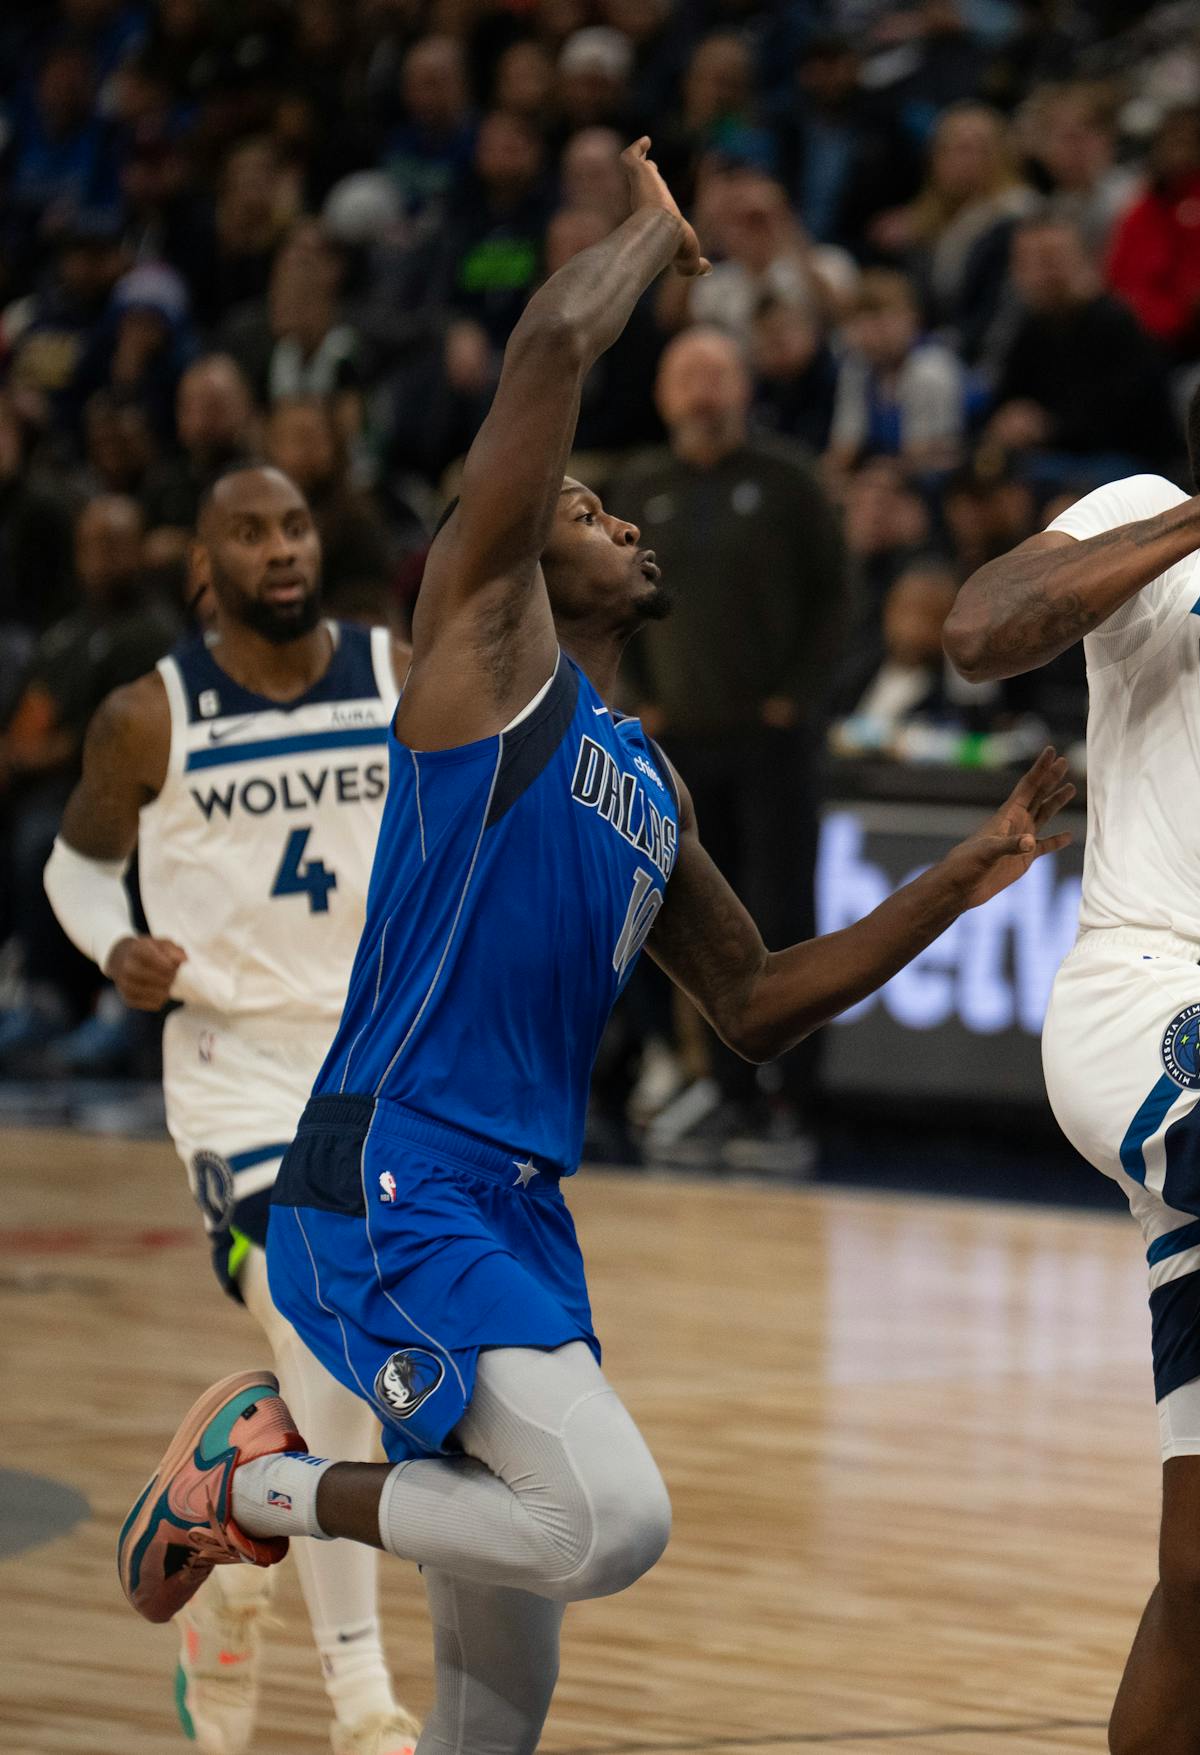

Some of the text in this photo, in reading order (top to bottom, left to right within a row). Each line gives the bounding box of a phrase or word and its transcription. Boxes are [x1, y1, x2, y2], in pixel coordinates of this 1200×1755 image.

[191, 762, 385, 822] WOLVES
[571, 733, 676, 882] DALLAS
[269, 825, 338, 914] 4
[1163, 1023, 1191, 1086] MINNESOTA
